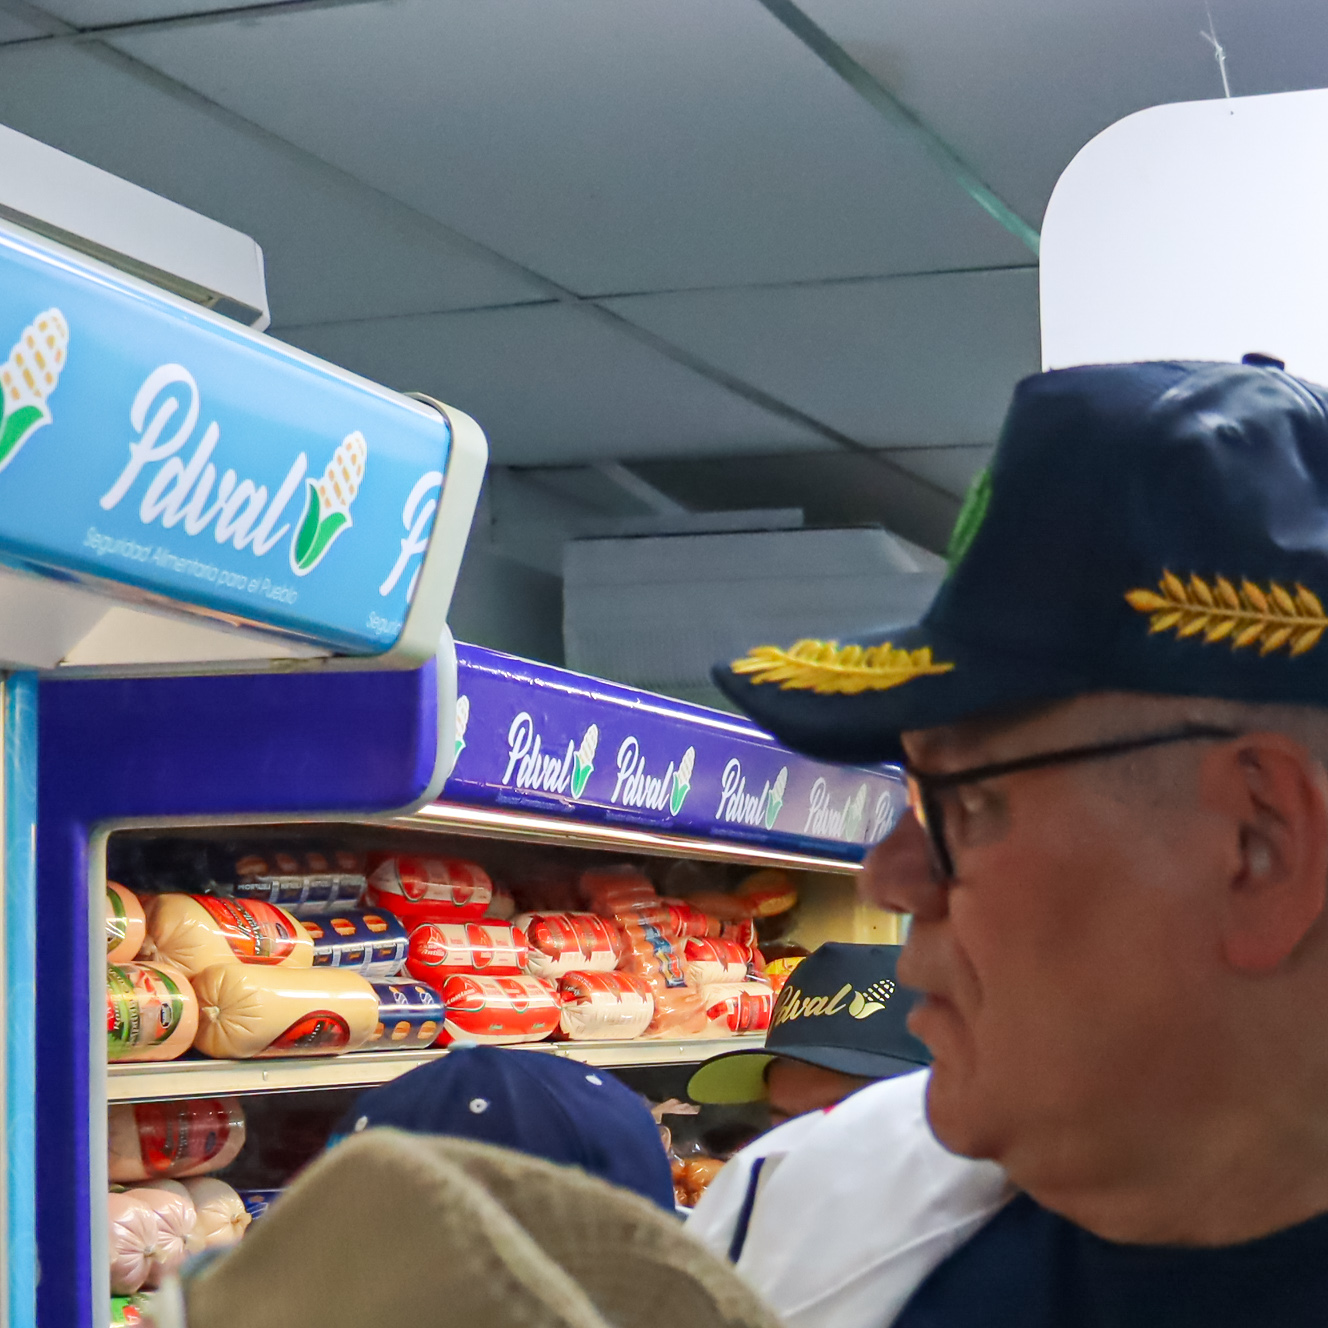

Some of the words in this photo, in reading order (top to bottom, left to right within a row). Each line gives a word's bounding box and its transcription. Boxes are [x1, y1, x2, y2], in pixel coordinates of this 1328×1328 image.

[100, 363, 306, 557] Pdval
[501, 711, 575, 794] Pdval
[611, 736, 675, 812] Pdval
[715, 757, 771, 826] Pdval
[803, 776, 851, 838] Pdval
